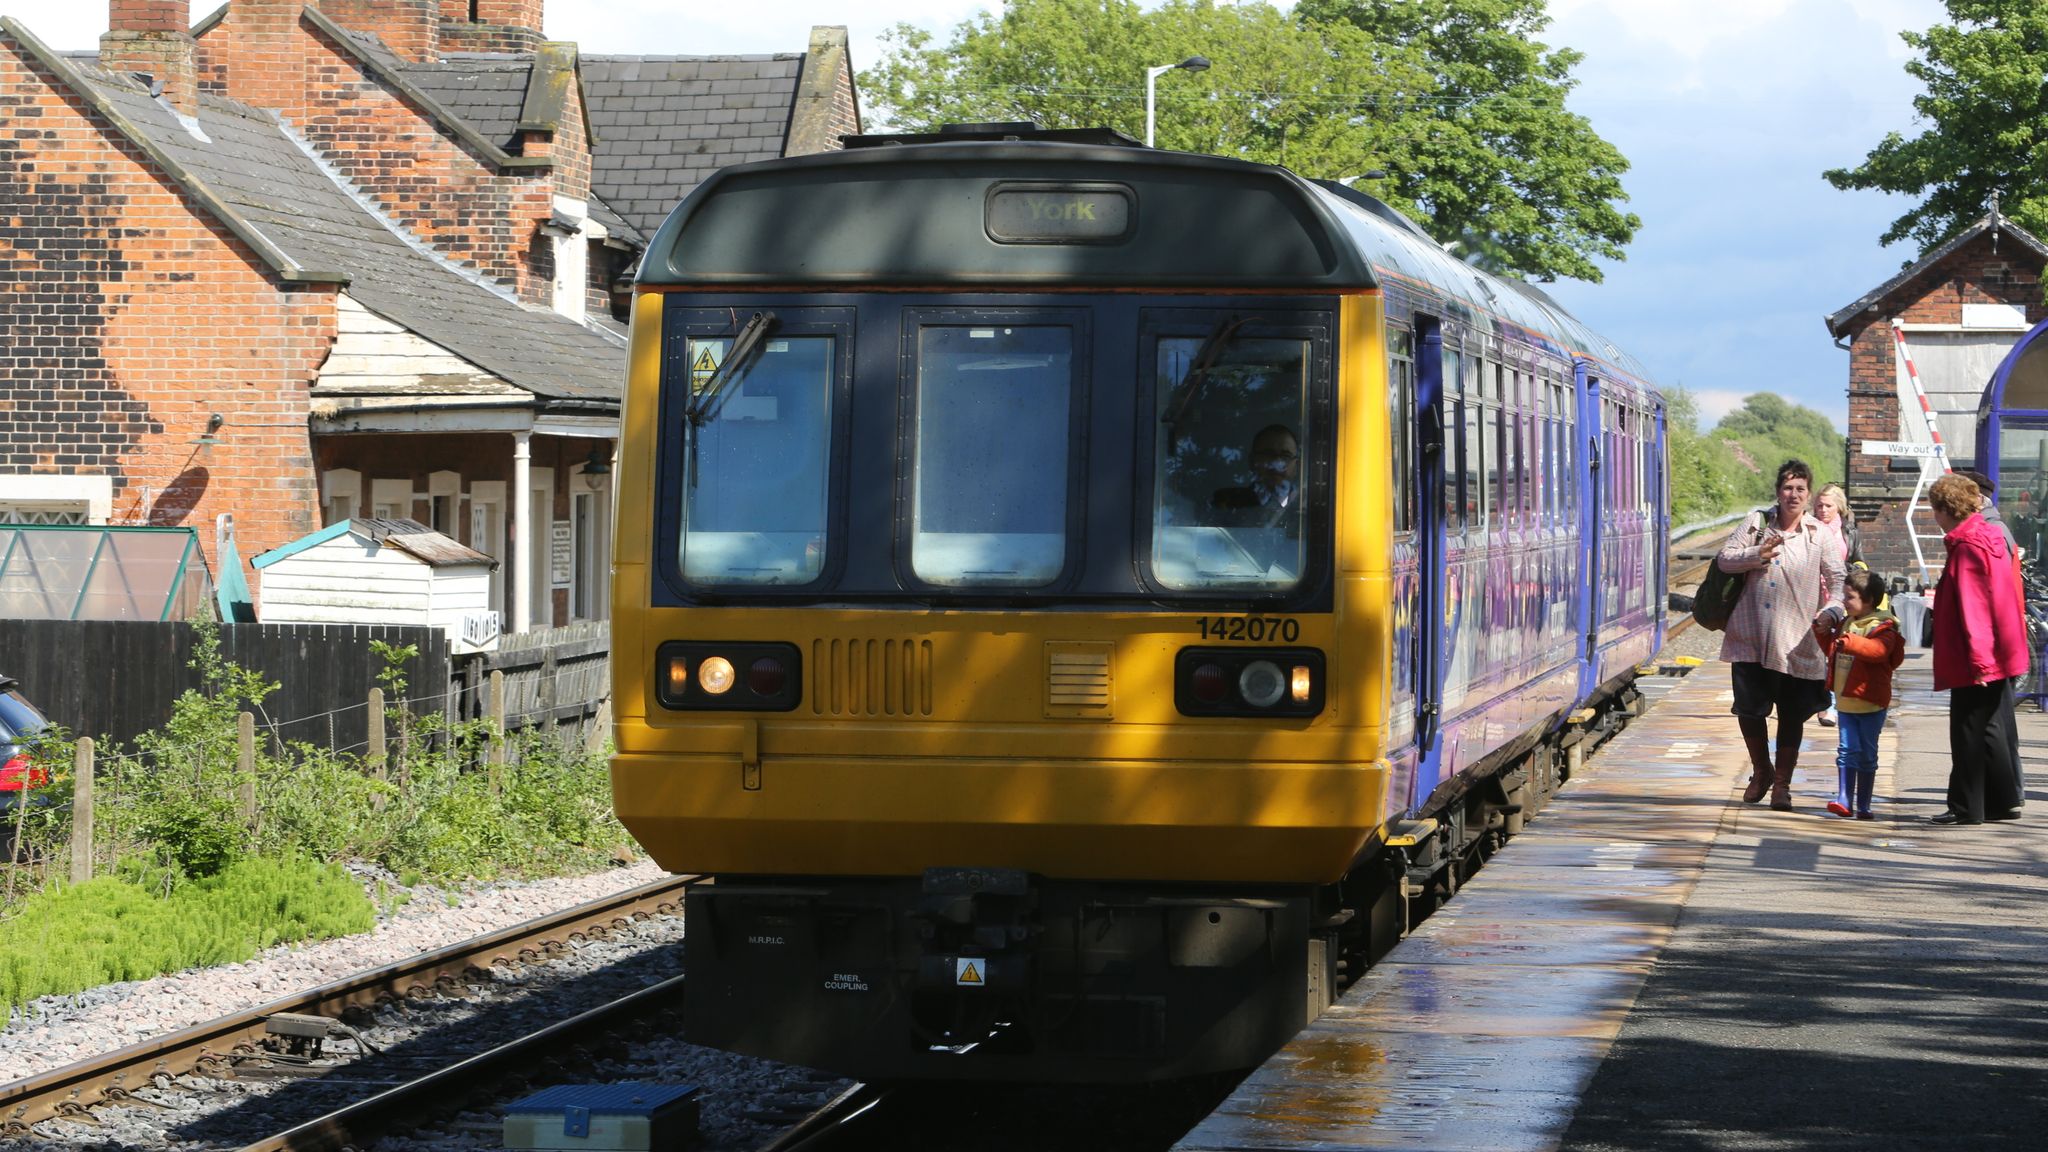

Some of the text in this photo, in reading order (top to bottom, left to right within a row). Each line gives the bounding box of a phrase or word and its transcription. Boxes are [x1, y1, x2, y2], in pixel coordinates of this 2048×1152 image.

[1026, 197, 1096, 221] York
[1888, 443, 1930, 455] Way out
[1196, 616, 1299, 642] 142070
[824, 981, 869, 991] COUPLING
